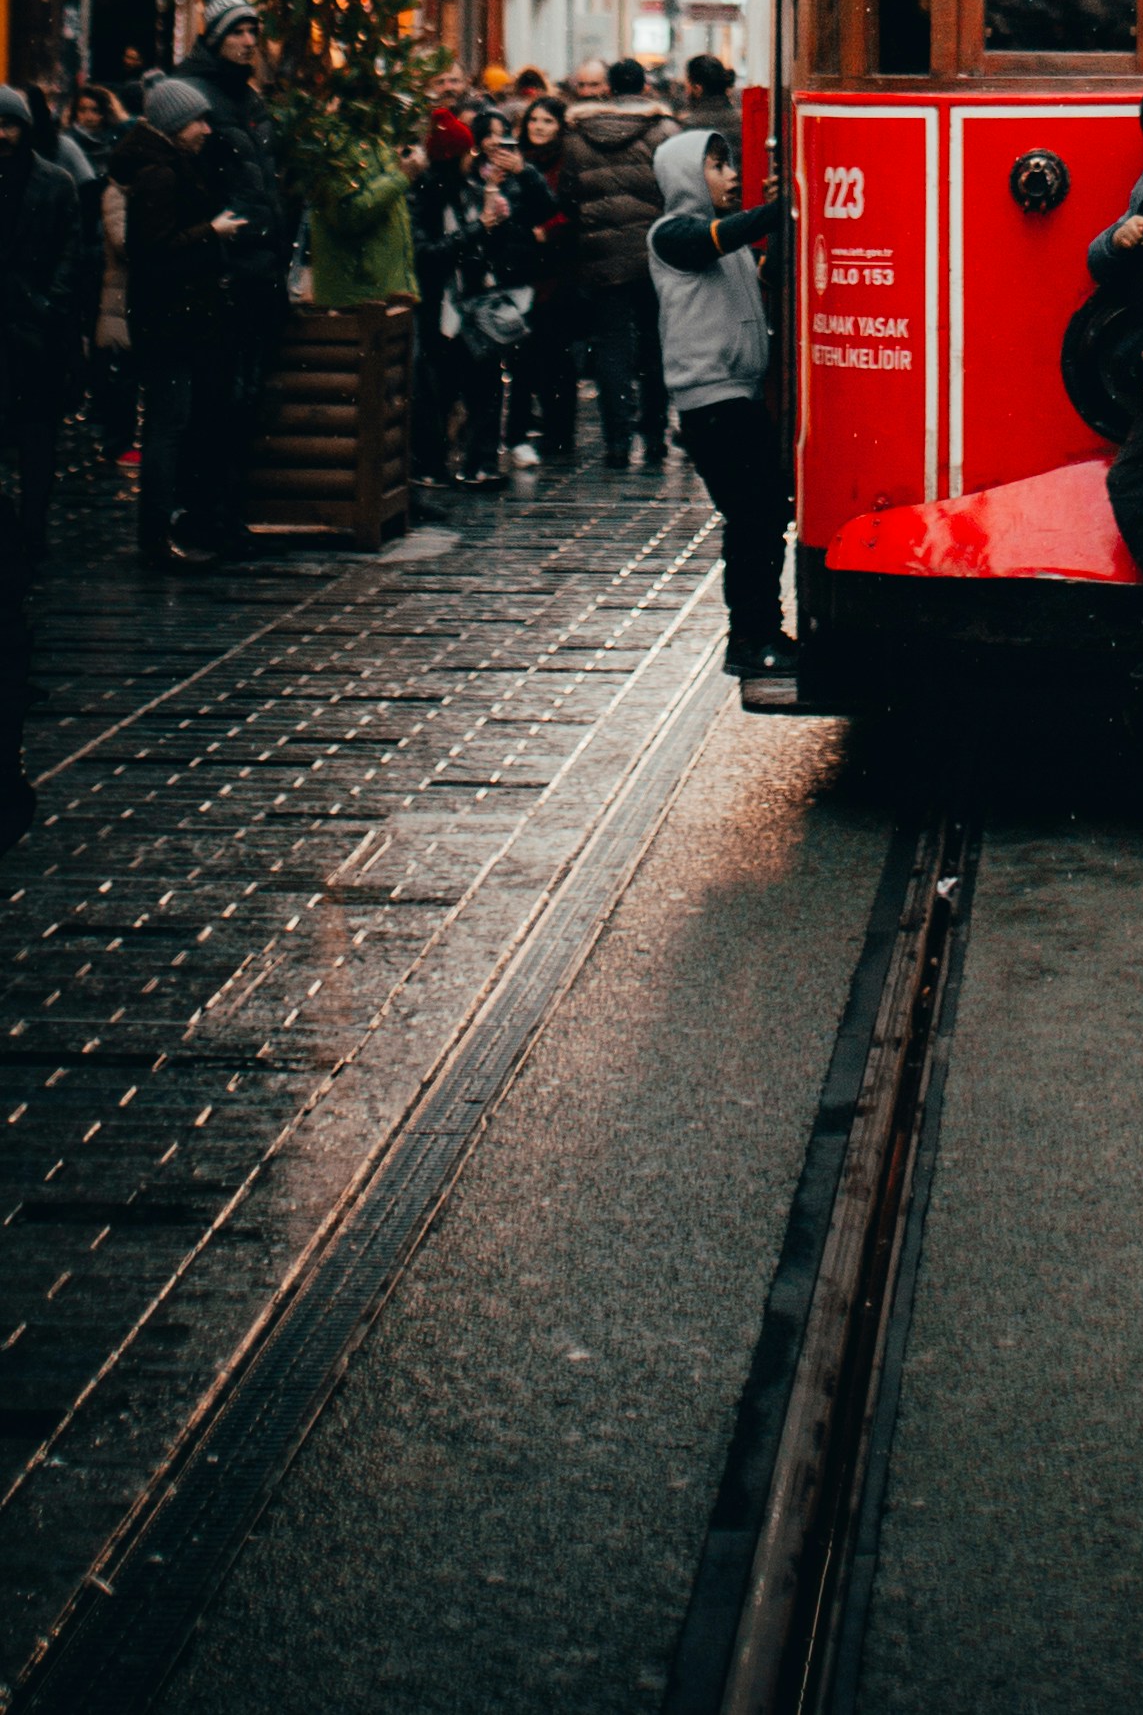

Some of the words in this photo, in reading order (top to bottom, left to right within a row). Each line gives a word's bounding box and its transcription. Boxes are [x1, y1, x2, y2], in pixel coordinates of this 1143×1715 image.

[824, 166, 865, 219] 223
[863, 268, 895, 286] 153
[857, 317, 909, 338] YASAK
